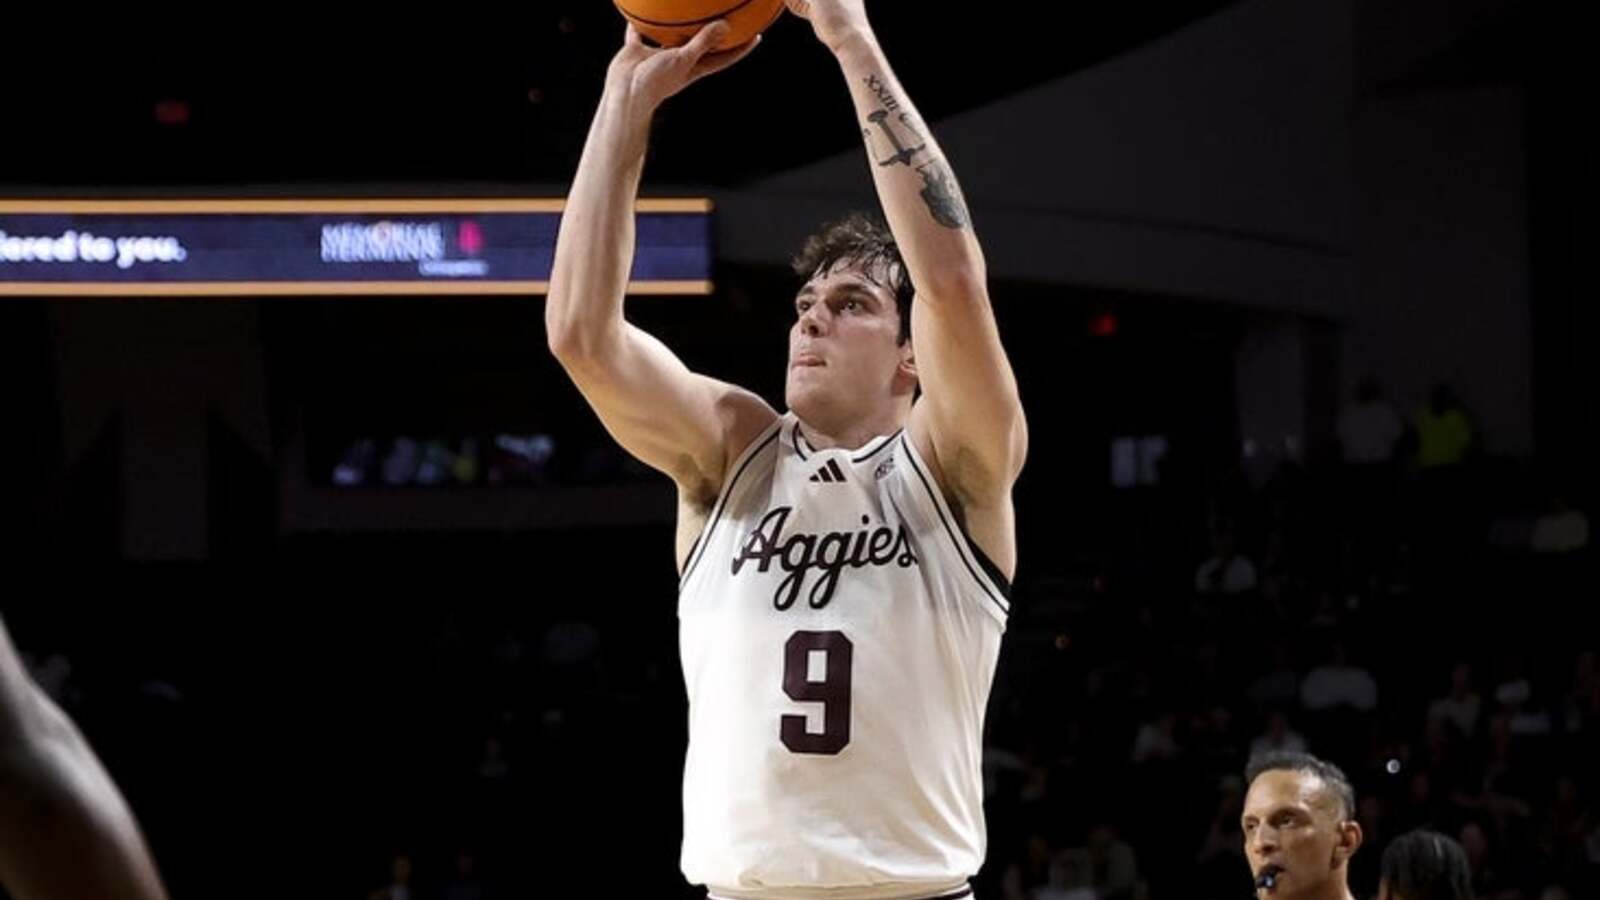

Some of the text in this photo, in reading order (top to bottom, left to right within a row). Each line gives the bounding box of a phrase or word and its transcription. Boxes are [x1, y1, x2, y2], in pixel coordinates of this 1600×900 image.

[79, 233, 115, 261] to
[117, 237, 187, 268] you.
[732, 506, 918, 611] Aggies
[779, 630, 853, 755] 9
